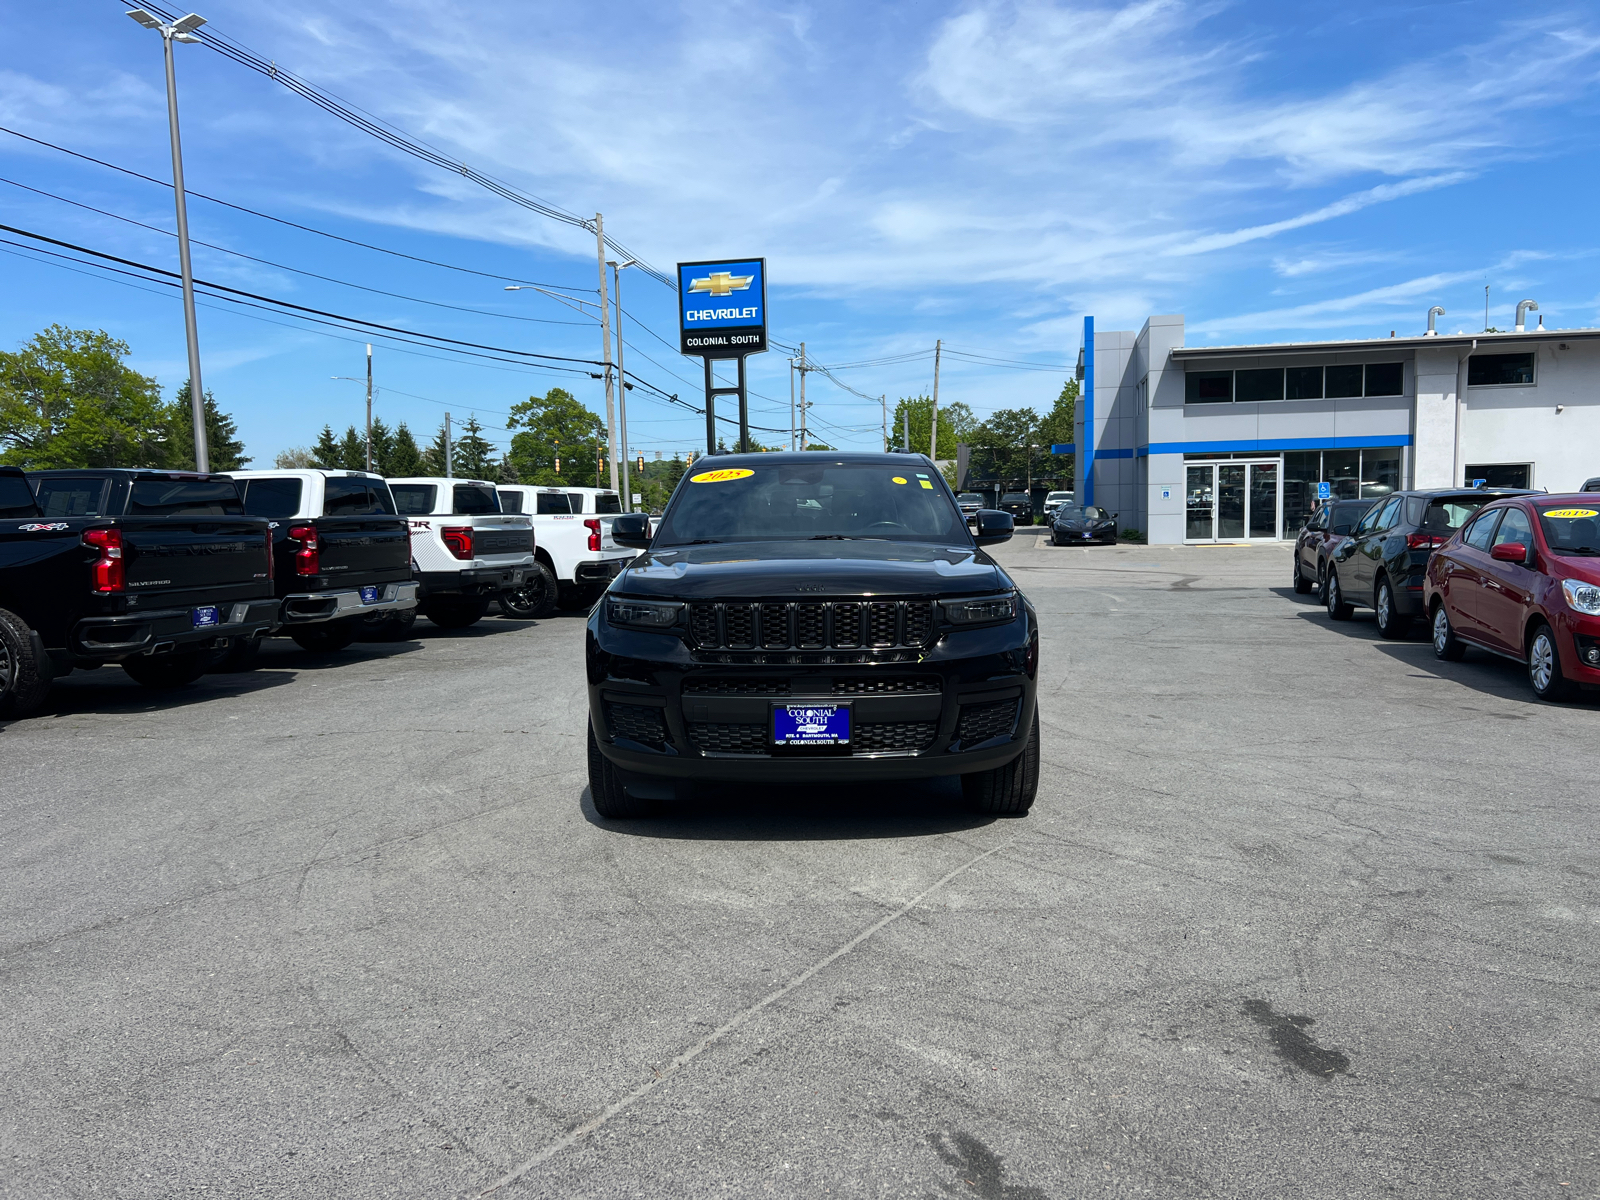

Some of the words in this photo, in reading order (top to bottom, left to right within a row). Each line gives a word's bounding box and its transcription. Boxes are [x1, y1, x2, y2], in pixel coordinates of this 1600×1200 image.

[687, 307, 758, 321] CHEVROLET
[687, 337, 729, 346] COLONIAL
[731, 335, 760, 344] SOUTH
[699, 470, 745, 481] 2025
[483, 537, 529, 548] FORD
[788, 709, 835, 717] COLONIAL
[795, 716, 828, 724] SOUTH
